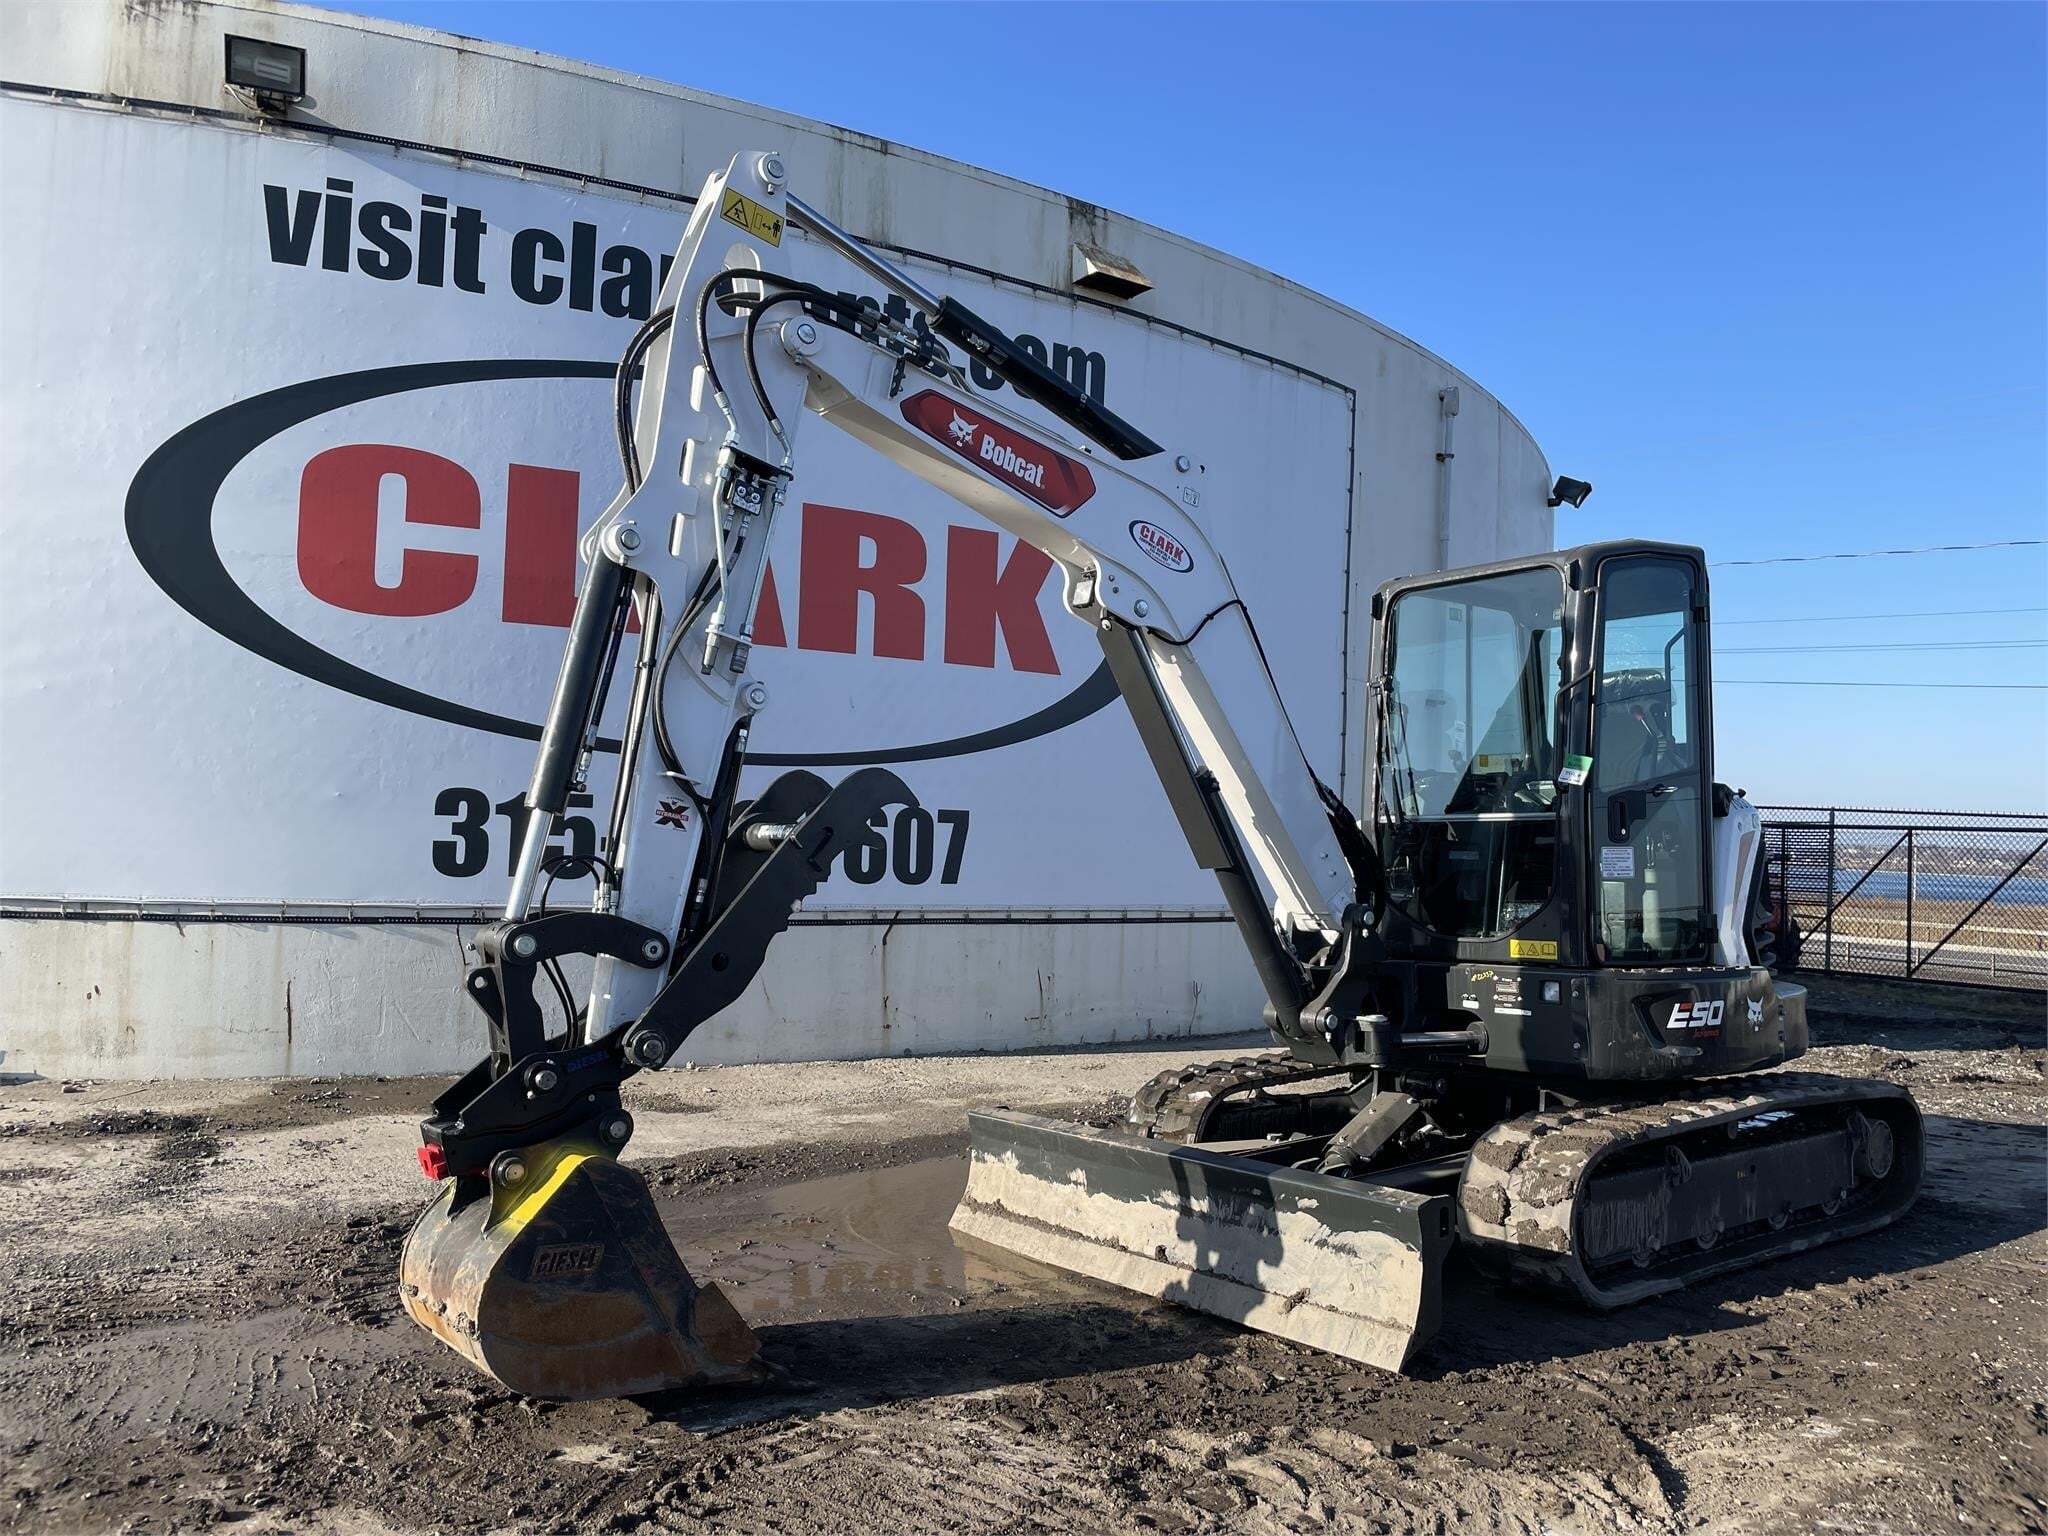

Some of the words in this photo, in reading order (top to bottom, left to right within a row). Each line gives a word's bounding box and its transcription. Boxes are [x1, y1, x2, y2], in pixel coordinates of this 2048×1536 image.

[263, 177, 487, 294] visit
[980, 434, 1044, 488] Bobcat
[297, 444, 1061, 675] CLRK
[1140, 525, 1184, 562] CLARK
[1666, 1000, 1725, 1029] E50
